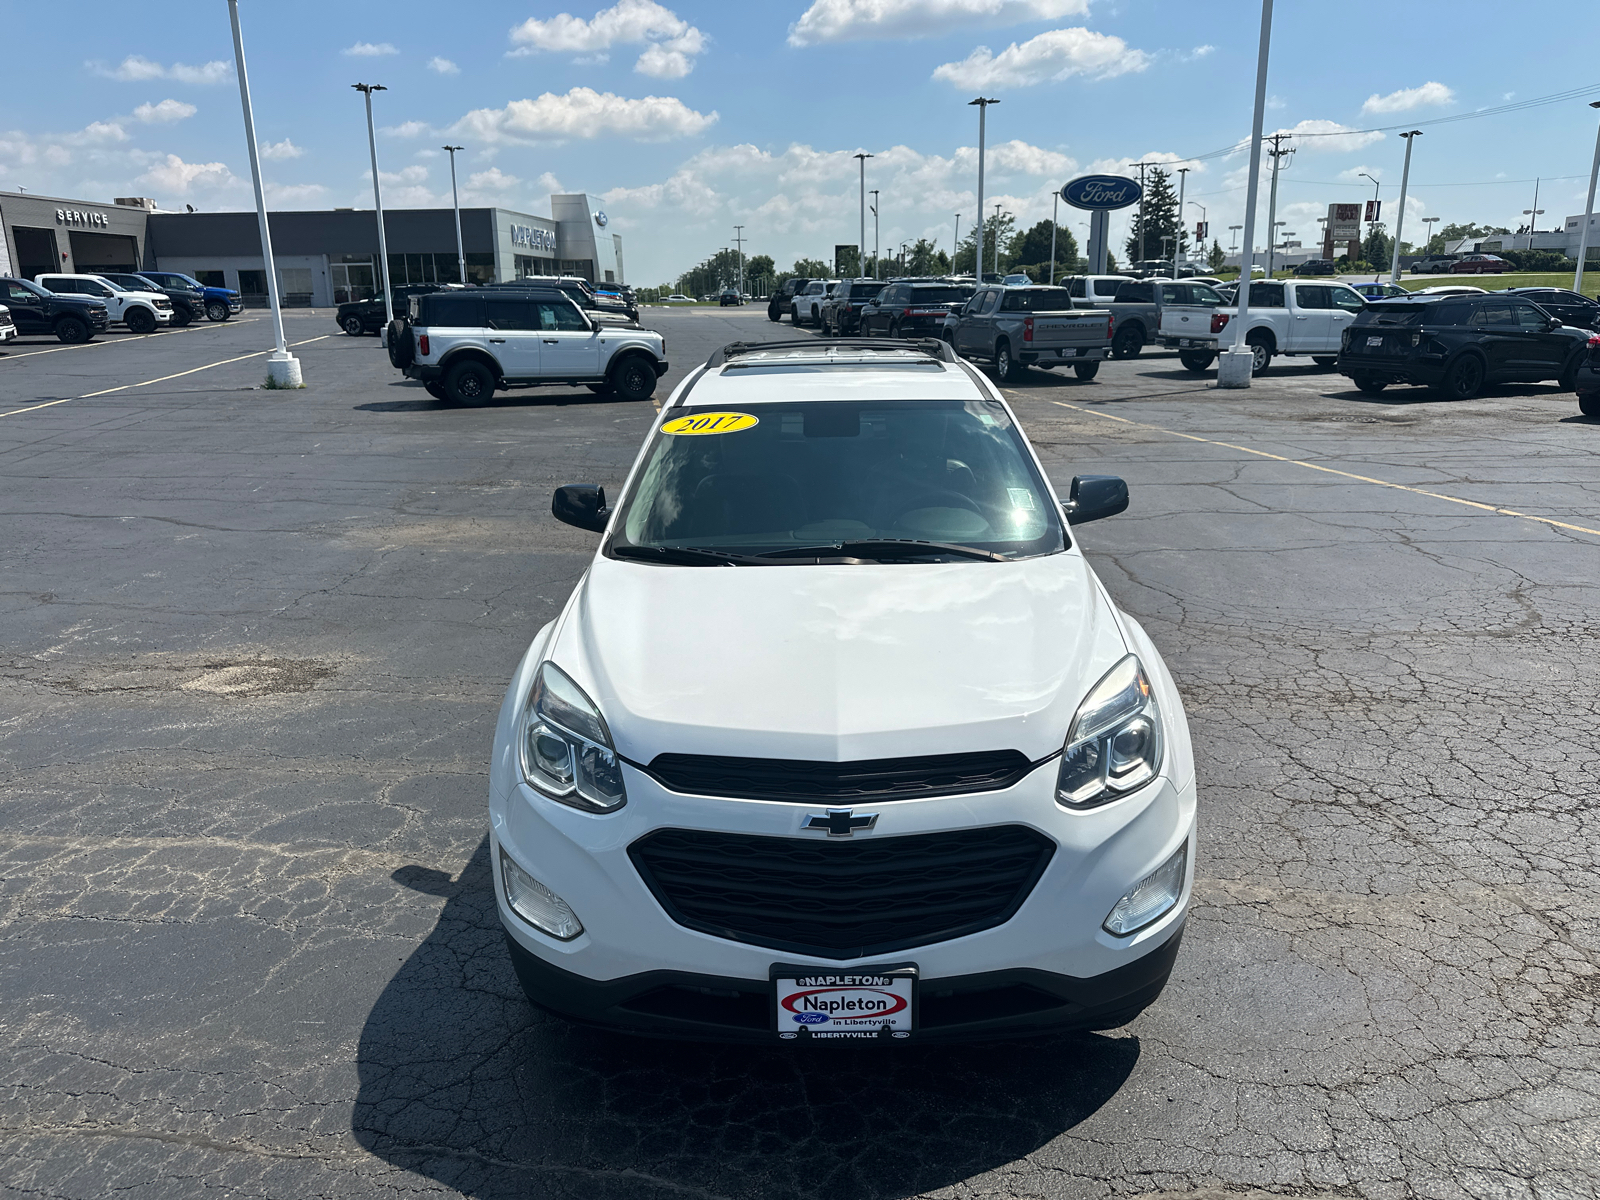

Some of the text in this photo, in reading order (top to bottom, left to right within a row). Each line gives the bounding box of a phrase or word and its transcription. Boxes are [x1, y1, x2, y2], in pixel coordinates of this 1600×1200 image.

[1080, 181, 1127, 202] Ford
[57, 209, 108, 224] SERVICE
[511, 224, 556, 249] NAPLETON
[674, 416, 744, 432] 2017
[806, 976, 883, 986] NAPLETON
[803, 996, 887, 1014] Napleton
[801, 1014, 822, 1023] Ford
[845, 1018, 897, 1026] Libertyville
